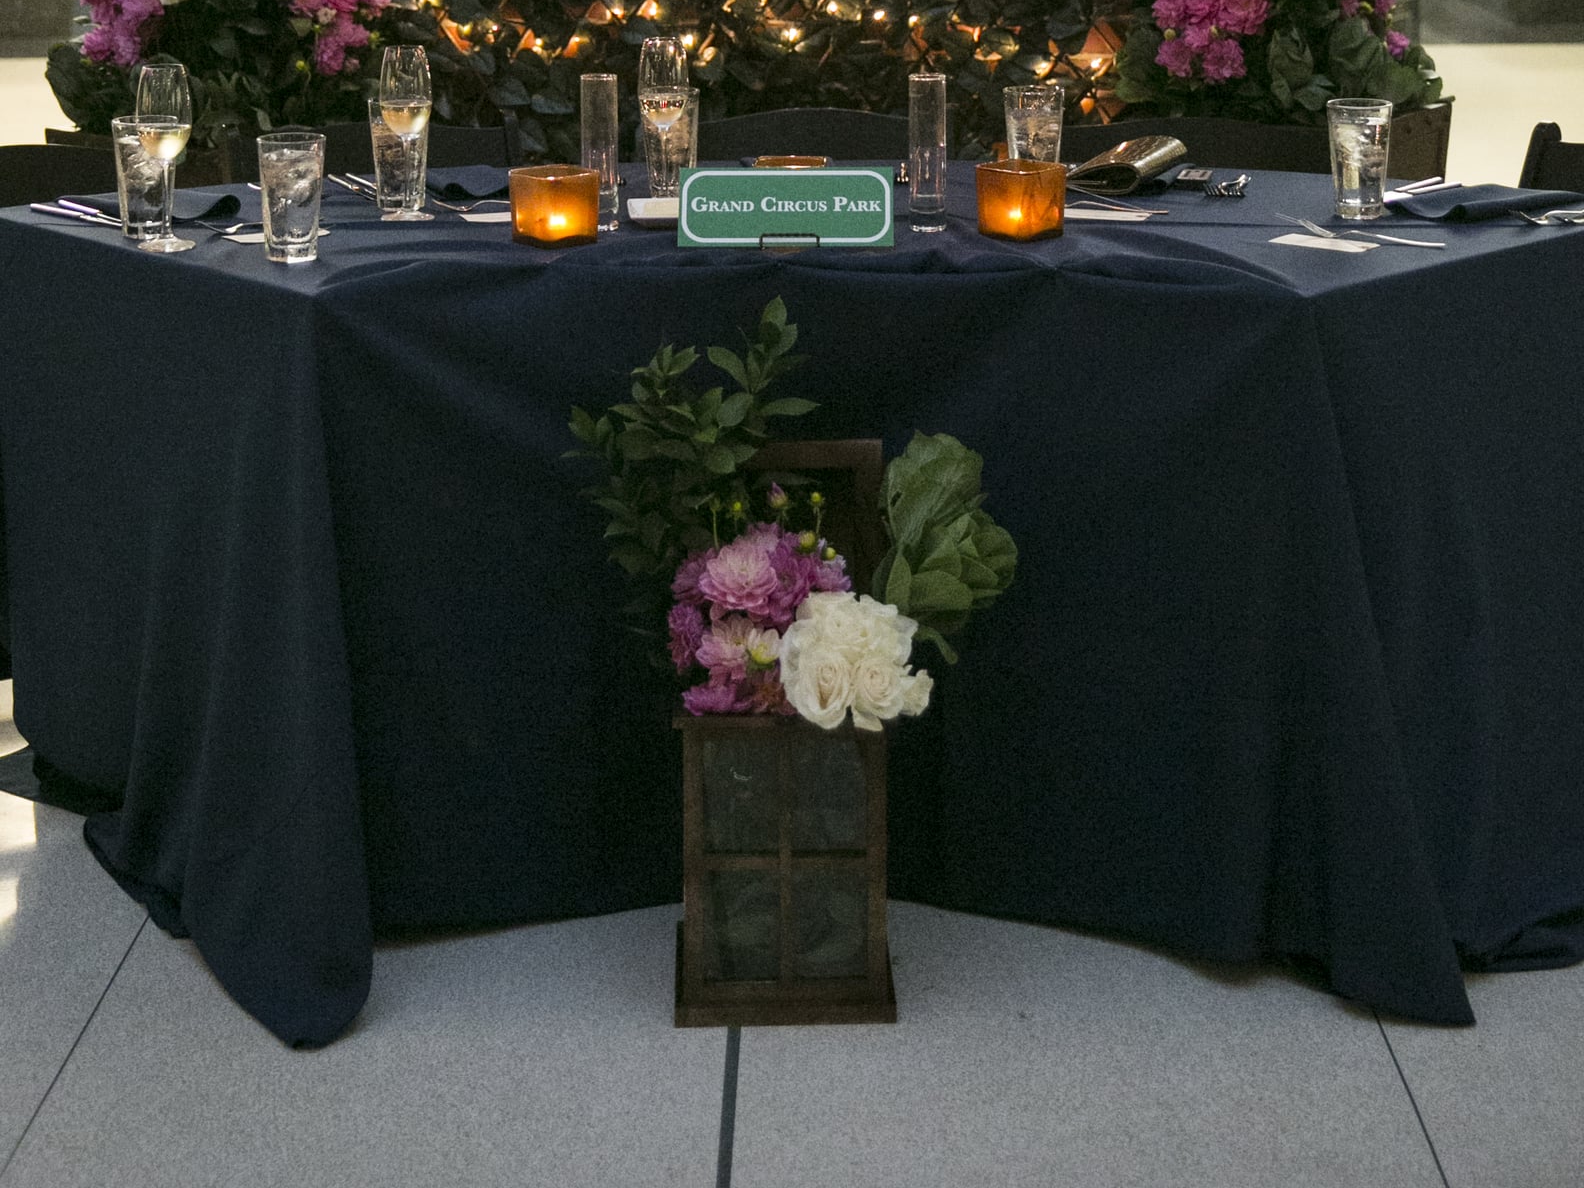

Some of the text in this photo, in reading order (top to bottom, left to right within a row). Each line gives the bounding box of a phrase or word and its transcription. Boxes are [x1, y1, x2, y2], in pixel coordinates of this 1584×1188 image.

[691, 196, 882, 212] GRAND CIRCUS PARK
